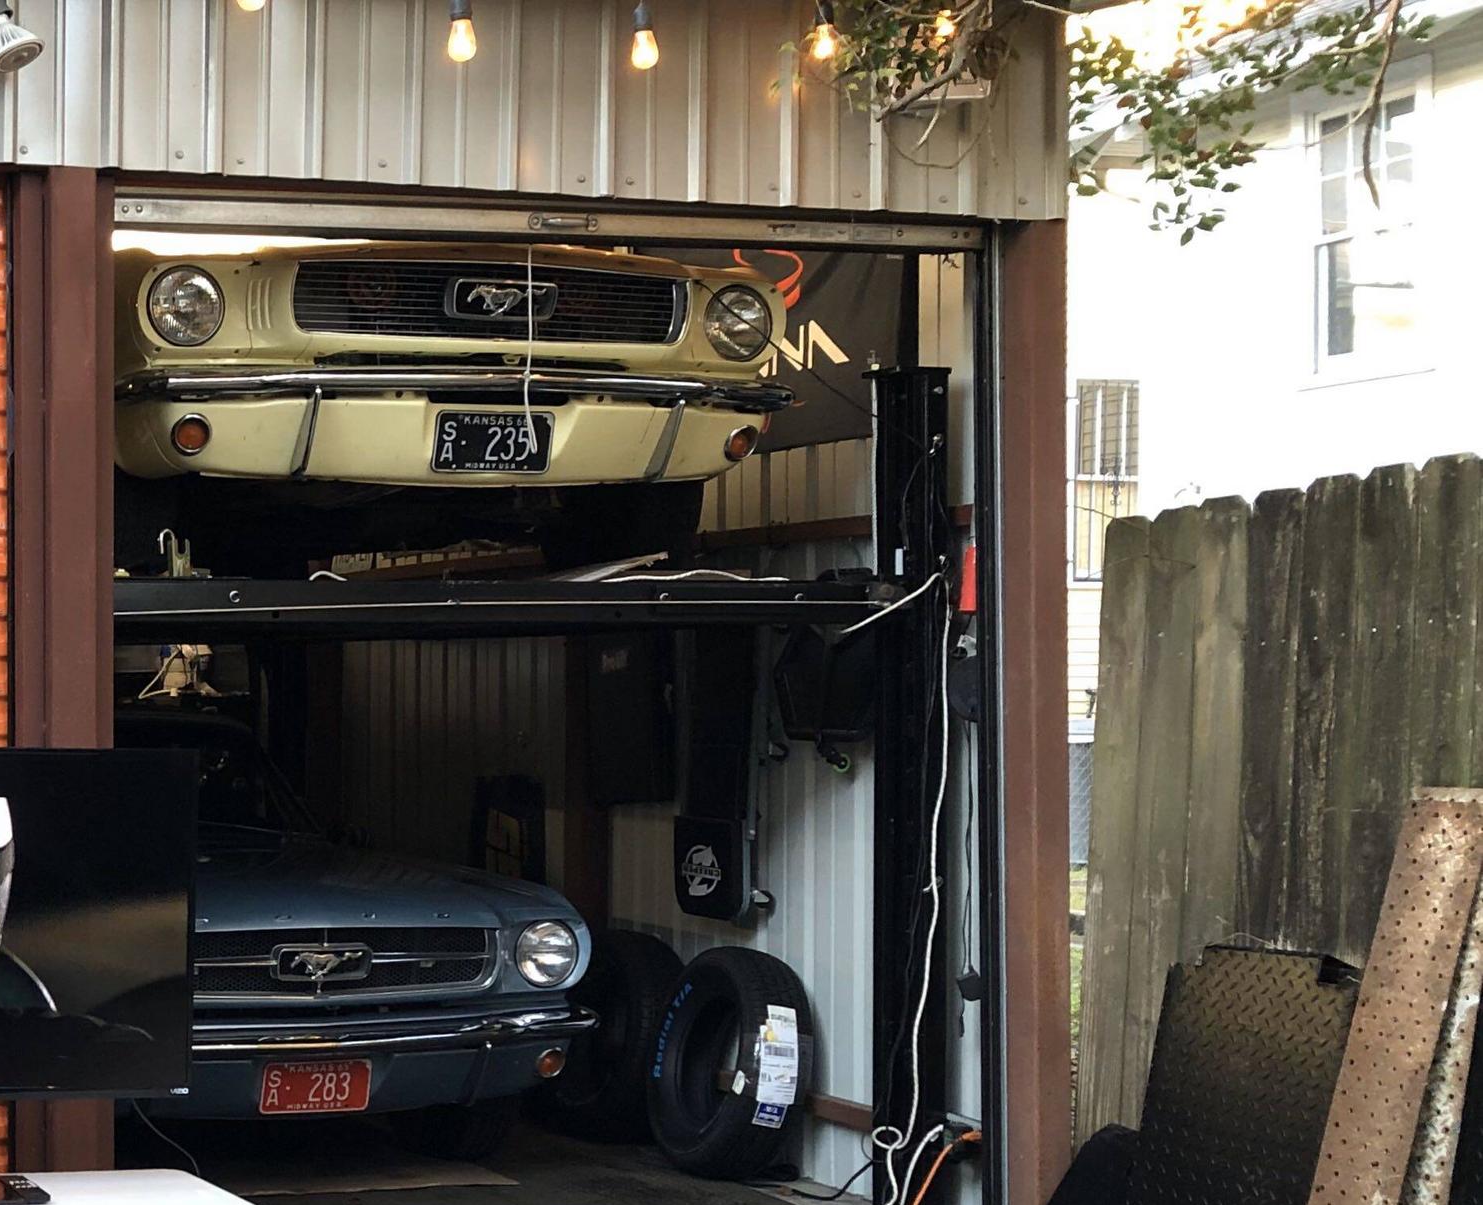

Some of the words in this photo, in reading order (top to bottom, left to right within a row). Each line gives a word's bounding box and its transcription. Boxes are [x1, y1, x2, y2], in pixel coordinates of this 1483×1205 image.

[463, 415, 514, 426] KANSAS
[485, 426, 530, 461] 235
[289, 1064, 336, 1073] KANSAS
[308, 1072, 351, 1102] 283
[286, 1102, 321, 1110] MIDWAY
[323, 1101, 343, 1109] USA
